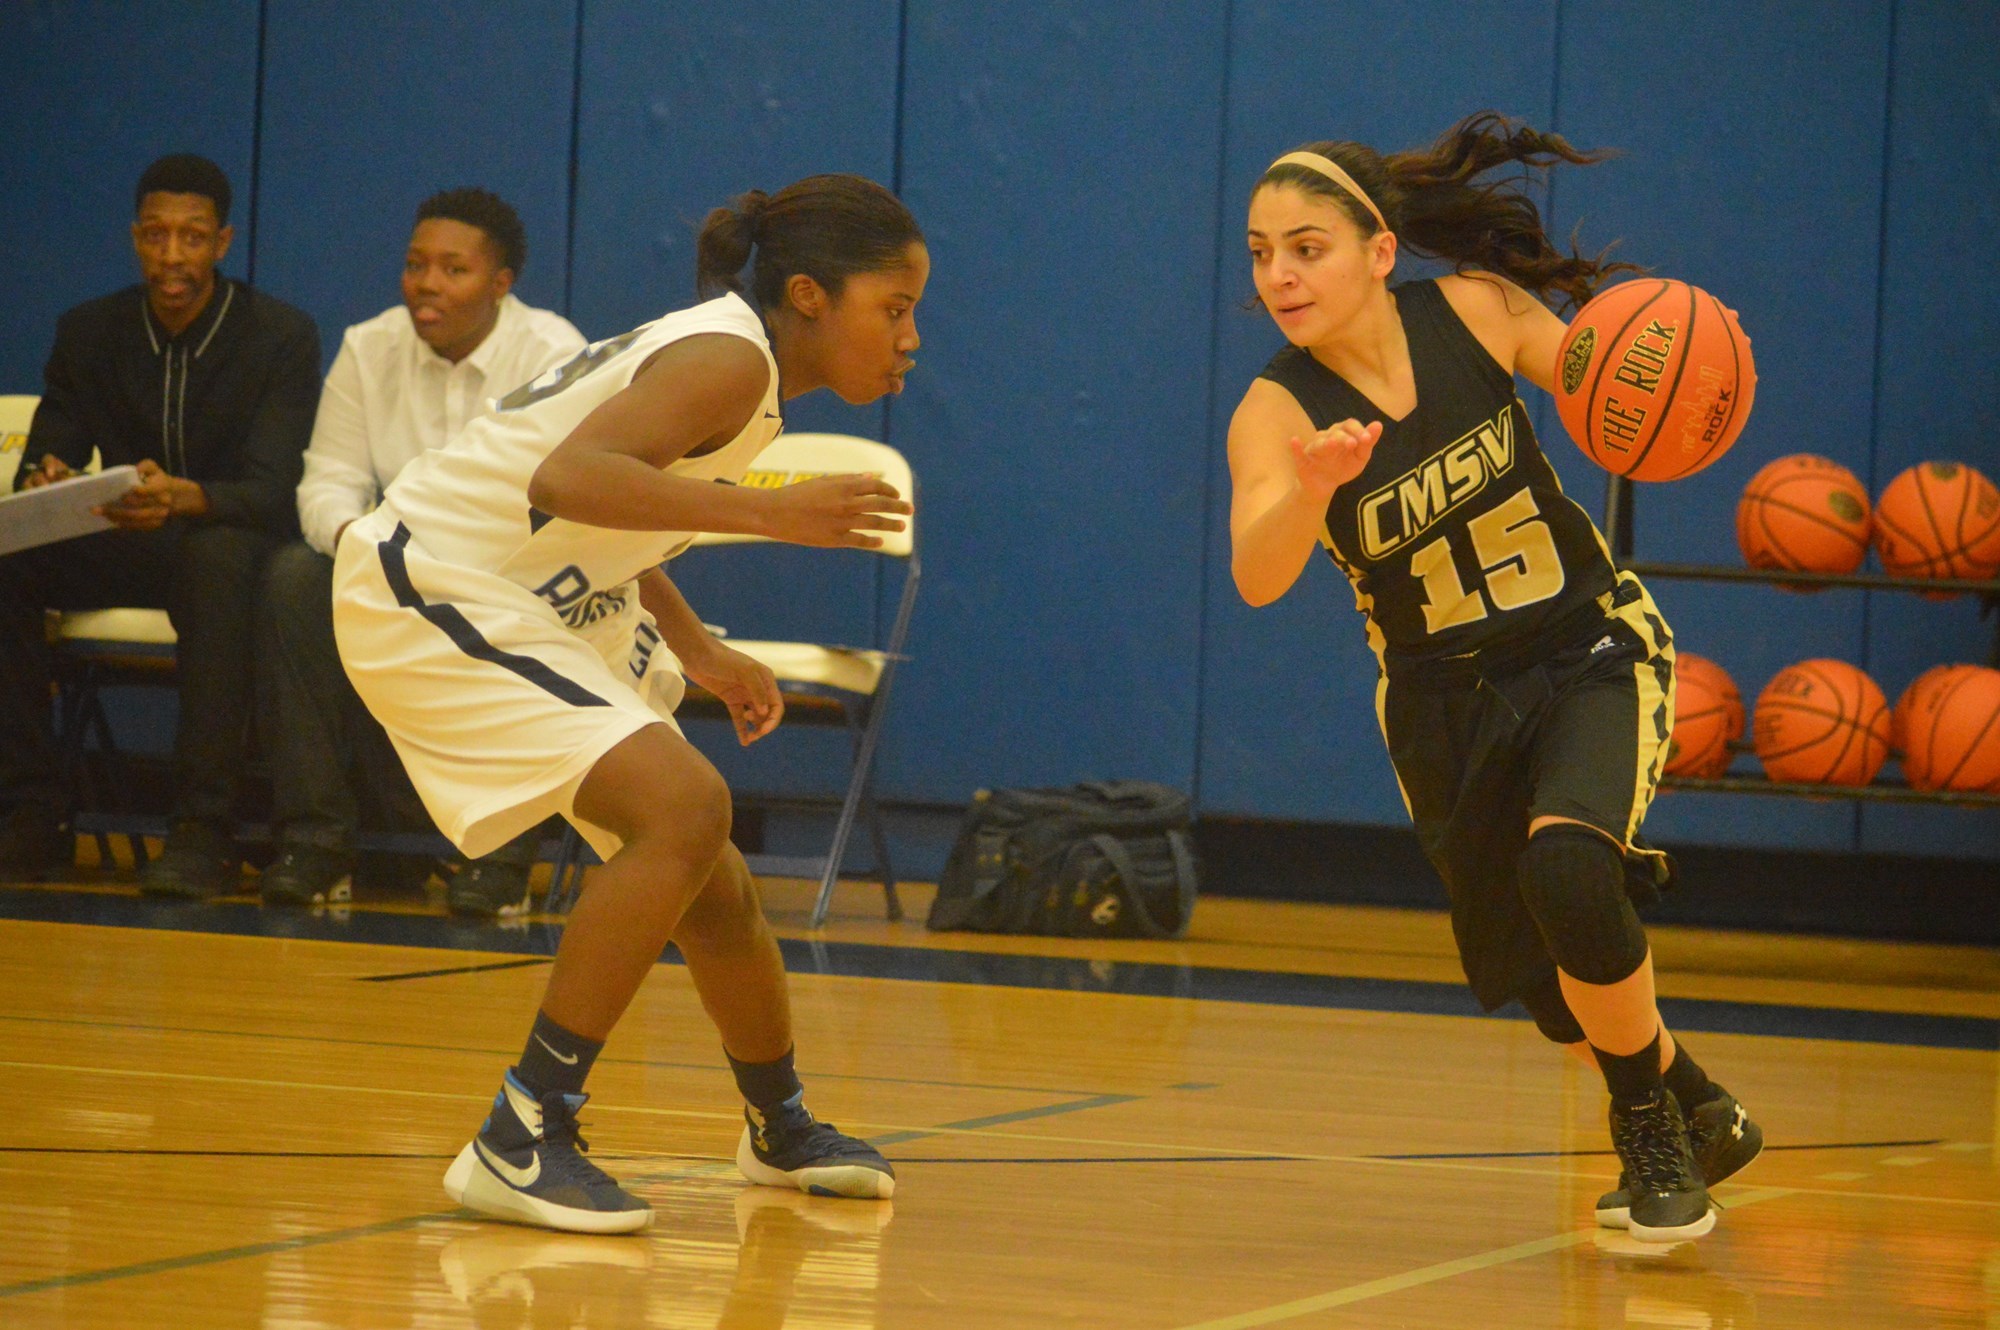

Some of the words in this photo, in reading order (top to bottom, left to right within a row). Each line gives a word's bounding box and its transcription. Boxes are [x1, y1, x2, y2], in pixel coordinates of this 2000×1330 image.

[1613, 319, 1677, 396] ROCK
[1602, 396, 1647, 454] THE
[1702, 386, 1732, 443] ROCK
[1357, 404, 1515, 561] CMSV
[1410, 486, 1566, 635] 15
